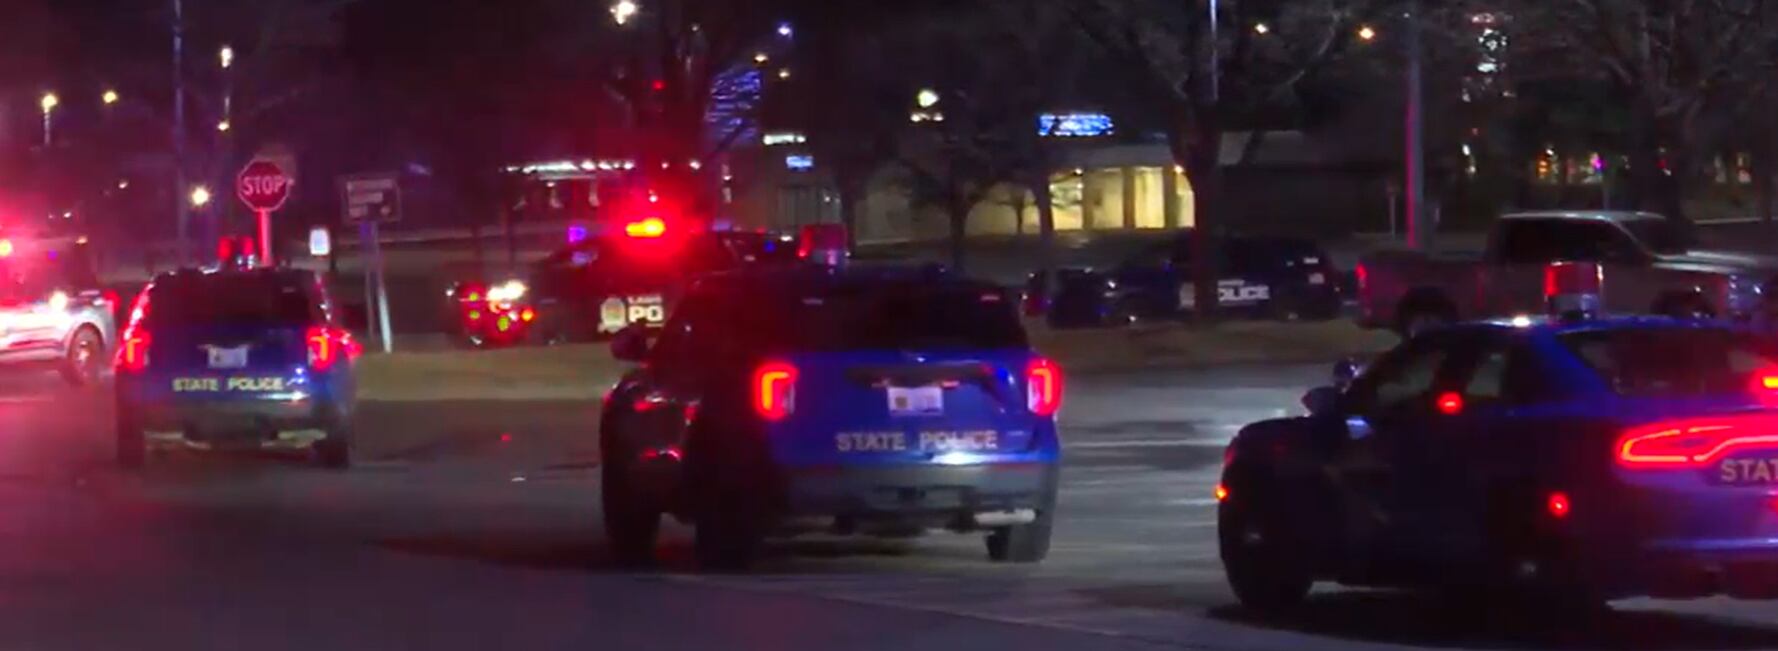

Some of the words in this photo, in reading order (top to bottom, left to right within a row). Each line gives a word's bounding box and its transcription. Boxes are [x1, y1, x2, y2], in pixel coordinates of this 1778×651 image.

[242, 175, 285, 195] STOP
[173, 377, 219, 392] STATE
[227, 376, 283, 391] POLICE
[836, 431, 906, 450] STATE
[920, 430, 998, 450] POLICE
